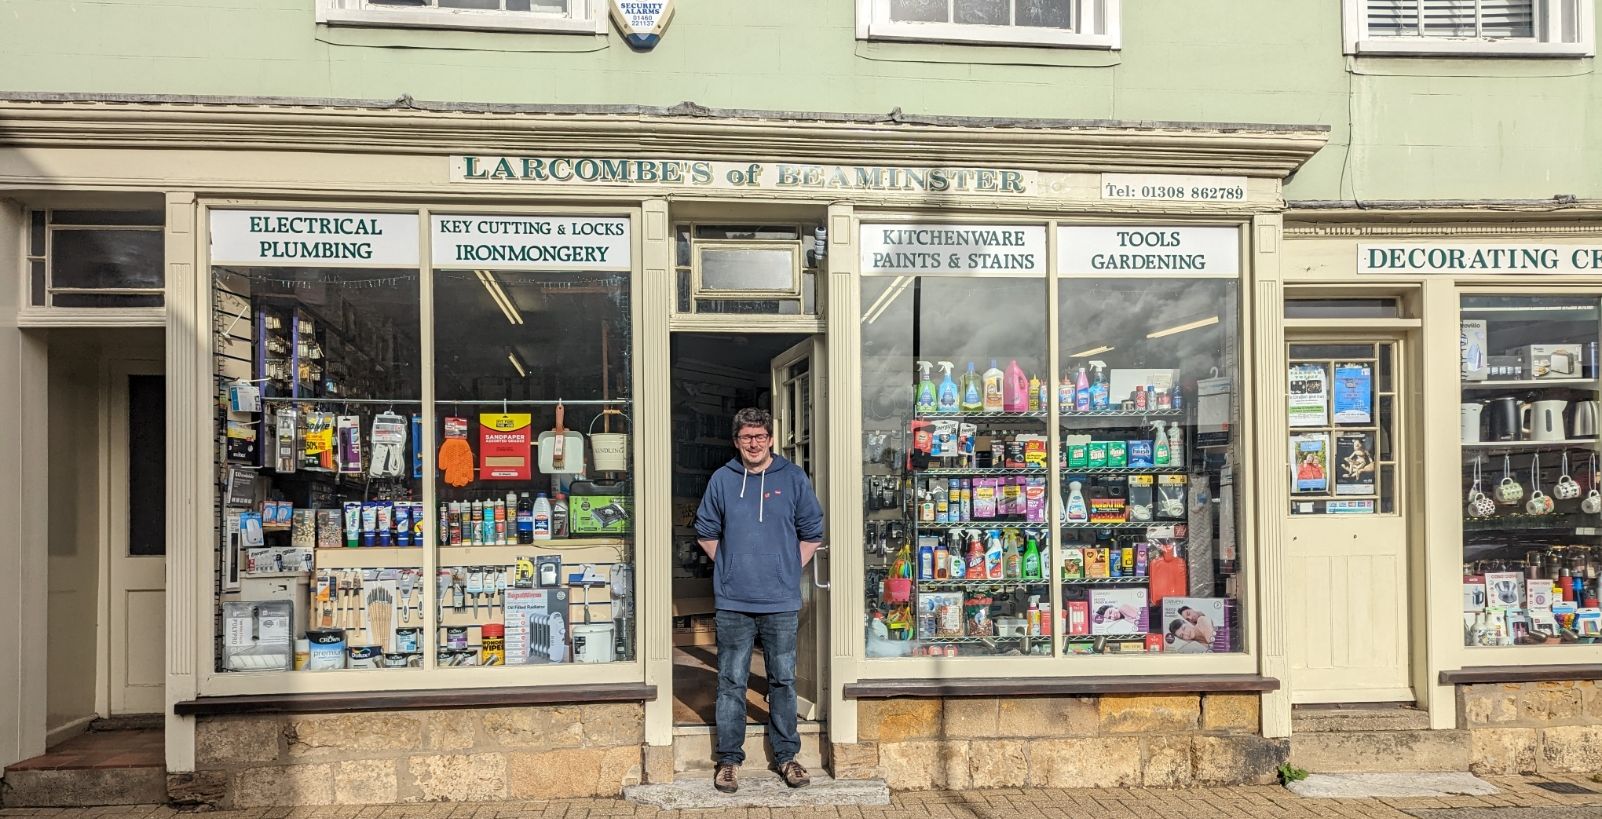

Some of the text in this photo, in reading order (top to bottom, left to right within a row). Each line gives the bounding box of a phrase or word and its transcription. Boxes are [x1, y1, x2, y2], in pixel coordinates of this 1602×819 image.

[462, 155, 1026, 194] LARCOMBE'S of BEAMINSTER
[1106, 184, 1244, 201] Tel: 01308 862789
[250, 216, 383, 236] ELECTRICAL
[440, 220, 625, 236] KEY CUTTING & LOCKS
[883, 229, 1026, 247] KITCHENWARE
[1117, 232, 1181, 247] TOOLS
[260, 241, 373, 259] PLUMBING
[456, 244, 609, 262] IRONMONGERY
[1367, 248, 1560, 270] DECORATING
[873, 252, 1035, 270] PAINTS & STAINS
[1091, 254, 1207, 270] GARDENING
